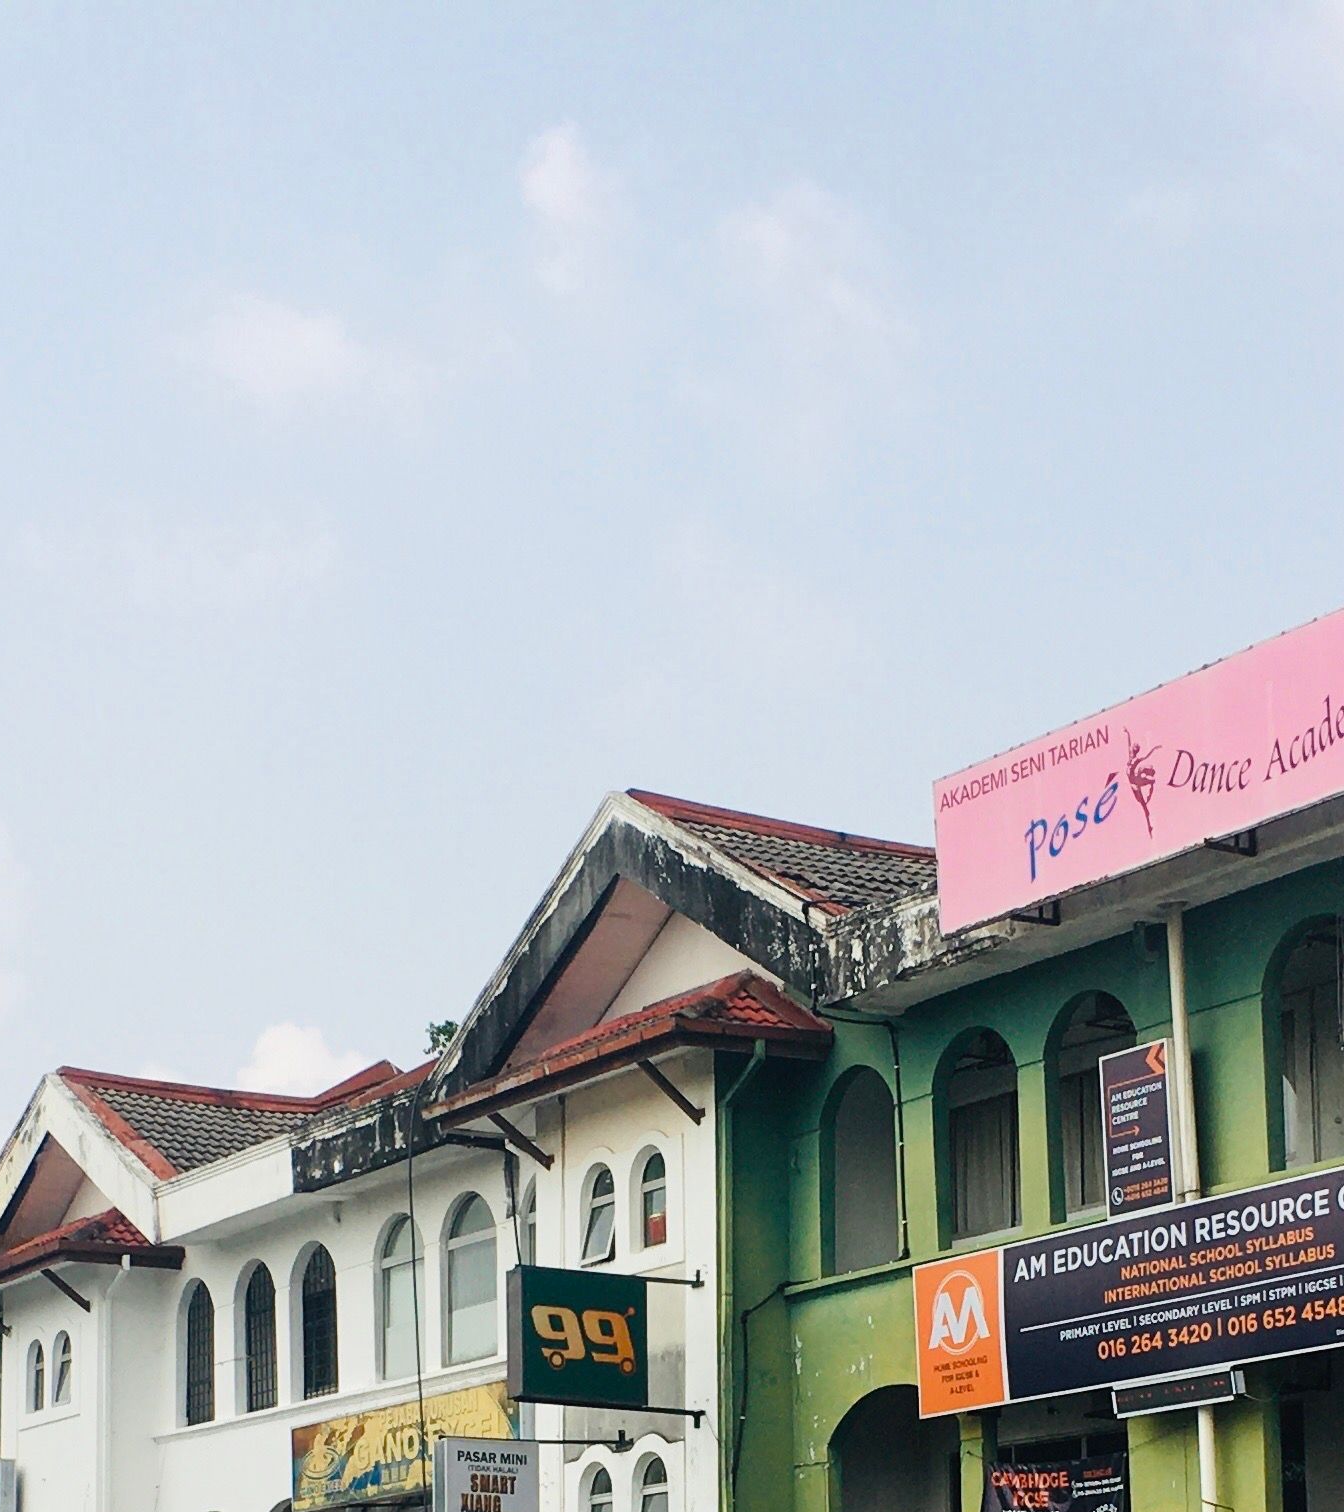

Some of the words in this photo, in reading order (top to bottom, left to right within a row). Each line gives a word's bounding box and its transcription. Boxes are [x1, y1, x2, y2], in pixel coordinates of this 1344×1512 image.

[940, 774, 1007, 812] AKADEMI
[1010, 756, 1046, 790] SENI
[1048, 725, 1109, 768] TARIAN
[1024, 774, 1120, 883] Posé
[1167, 749, 1252, 794] Dance
[1014, 1250, 1047, 1283] AM
[1053, 1220, 1188, 1275] EDUCATION
[1194, 1189, 1330, 1243] RESOURCE
[1120, 1256, 1186, 1281] NATIONAL
[1189, 1243, 1243, 1268] SCHOOL
[1246, 1227, 1314, 1255] SYLLABUS
[1104, 1272, 1206, 1304] INTERNATIONAL
[1209, 1258, 1262, 1284] SCHOOL
[1265, 1243, 1336, 1272] SYLLABUS
[1059, 1322, 1099, 1342] PRIMARY
[1101, 1317, 1132, 1335] LEVEL
[1139, 1304, 1199, 1327] SECONDARY
[1201, 1298, 1233, 1317] LEVEL
[1240, 1292, 1261, 1309] SPM
[1268, 1285, 1297, 1304] STPM
[1304, 1278, 1338, 1298] IGCSE
[1097, 1338, 1127, 1361] 016
[1130, 1332, 1164, 1356] 264
[1167, 1323, 1212, 1349] 3420
[1228, 1312, 1258, 1337] 016
[1262, 1305, 1297, 1330] 652
[531, 1304, 638, 1375] 99
[353, 1428, 420, 1471] GANO
[457, 1450, 498, 1465] PASAR
[500, 1452, 528, 1465] MINI
[460, 1493, 501, 1512] XIANG
[470, 1473, 517, 1494] SMART
